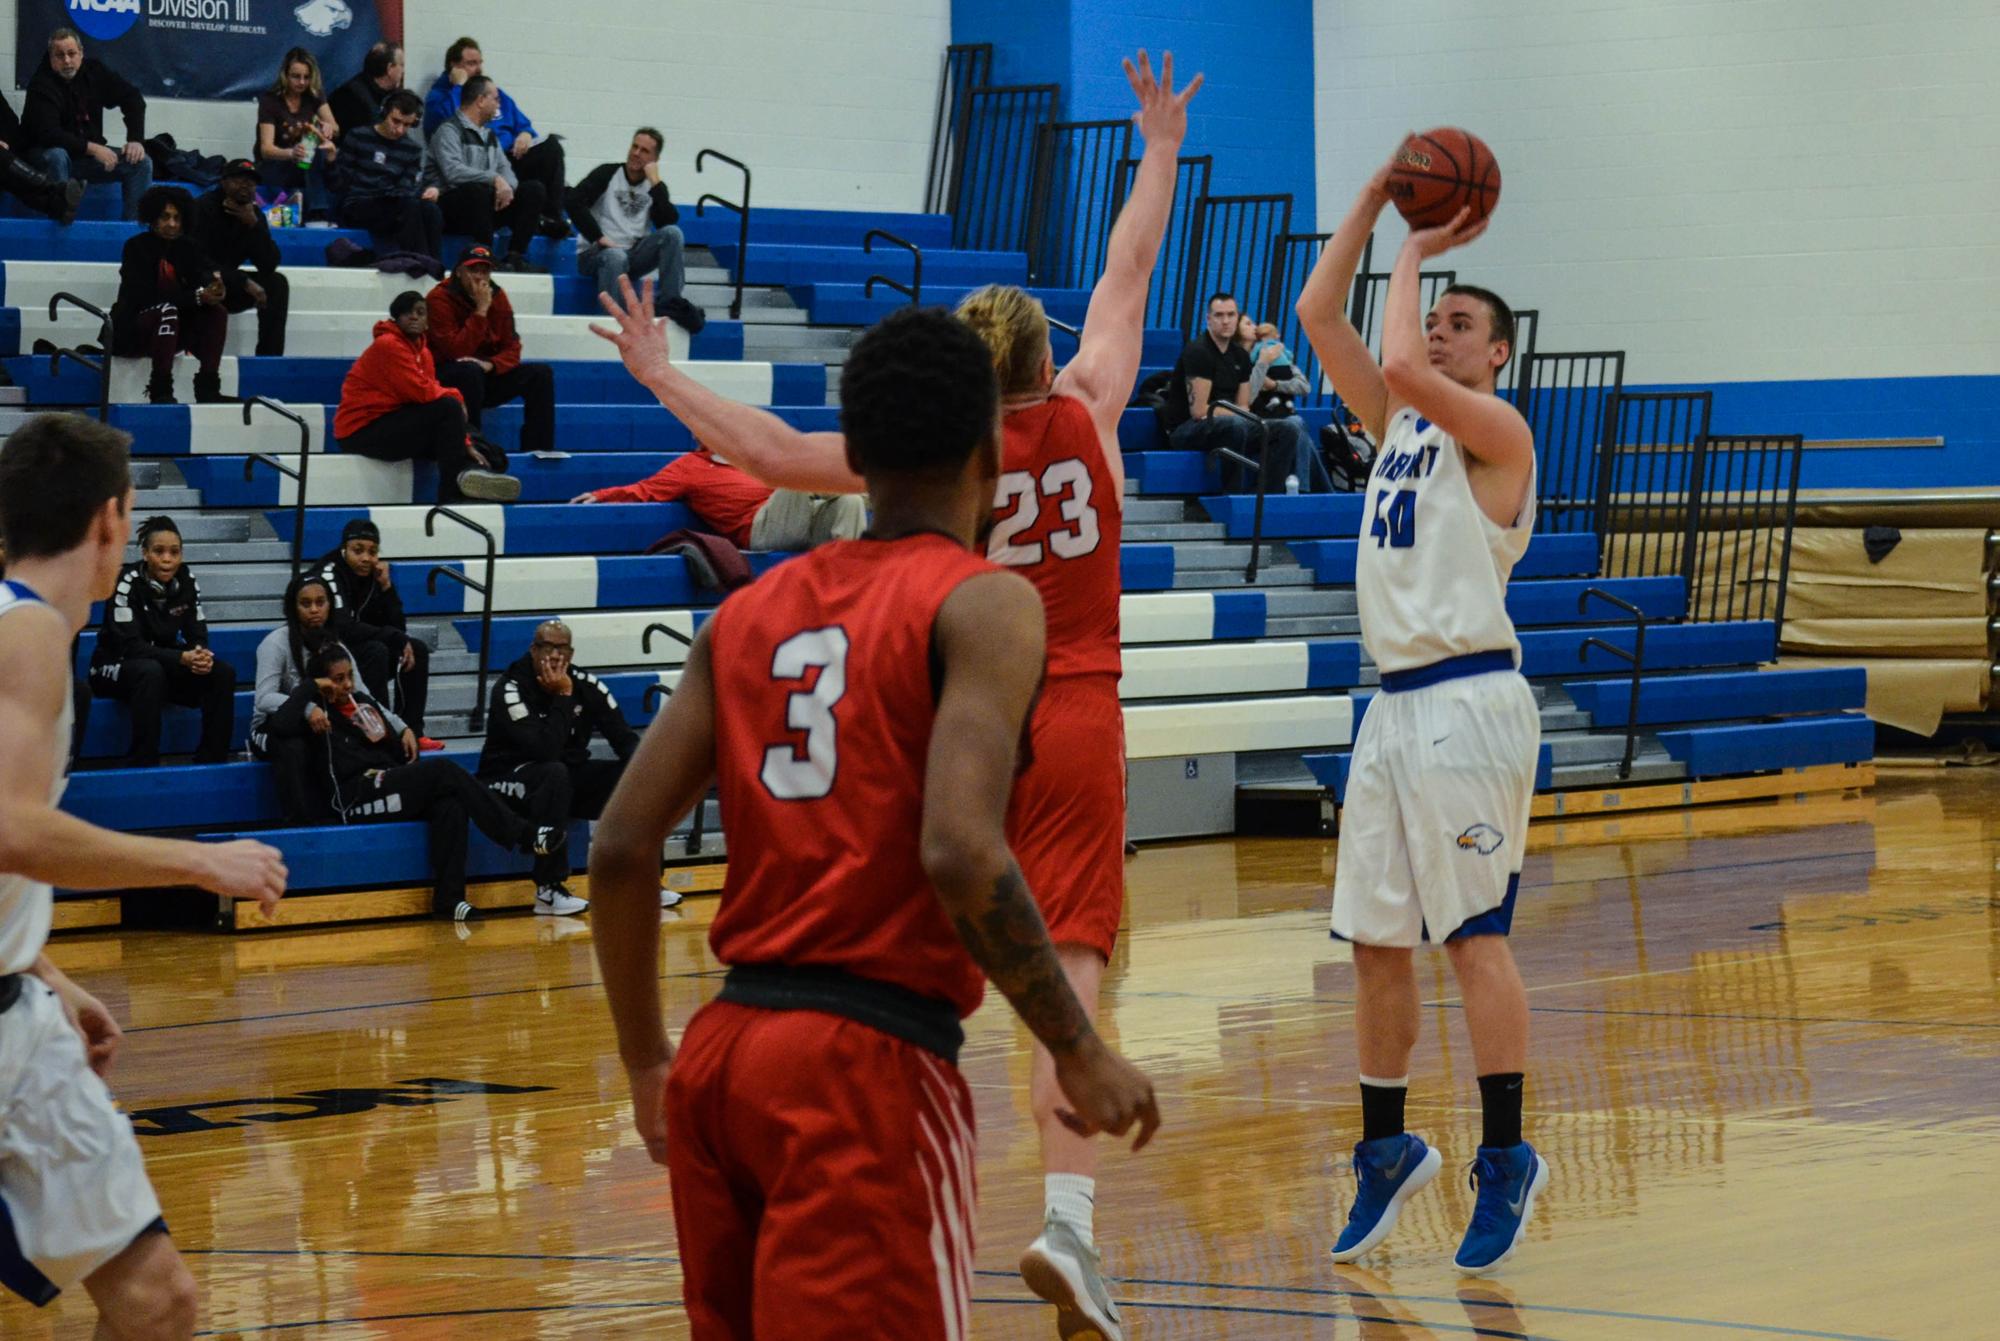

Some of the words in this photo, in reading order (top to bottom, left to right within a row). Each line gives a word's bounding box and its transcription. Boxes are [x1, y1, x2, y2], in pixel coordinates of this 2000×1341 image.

[148, 18, 186, 29] DISCOVER
[190, 22, 225, 31] DEVELOP
[229, 24, 267, 34] DEDICATE
[985, 457, 1101, 567] 23
[759, 624, 850, 801] 3
